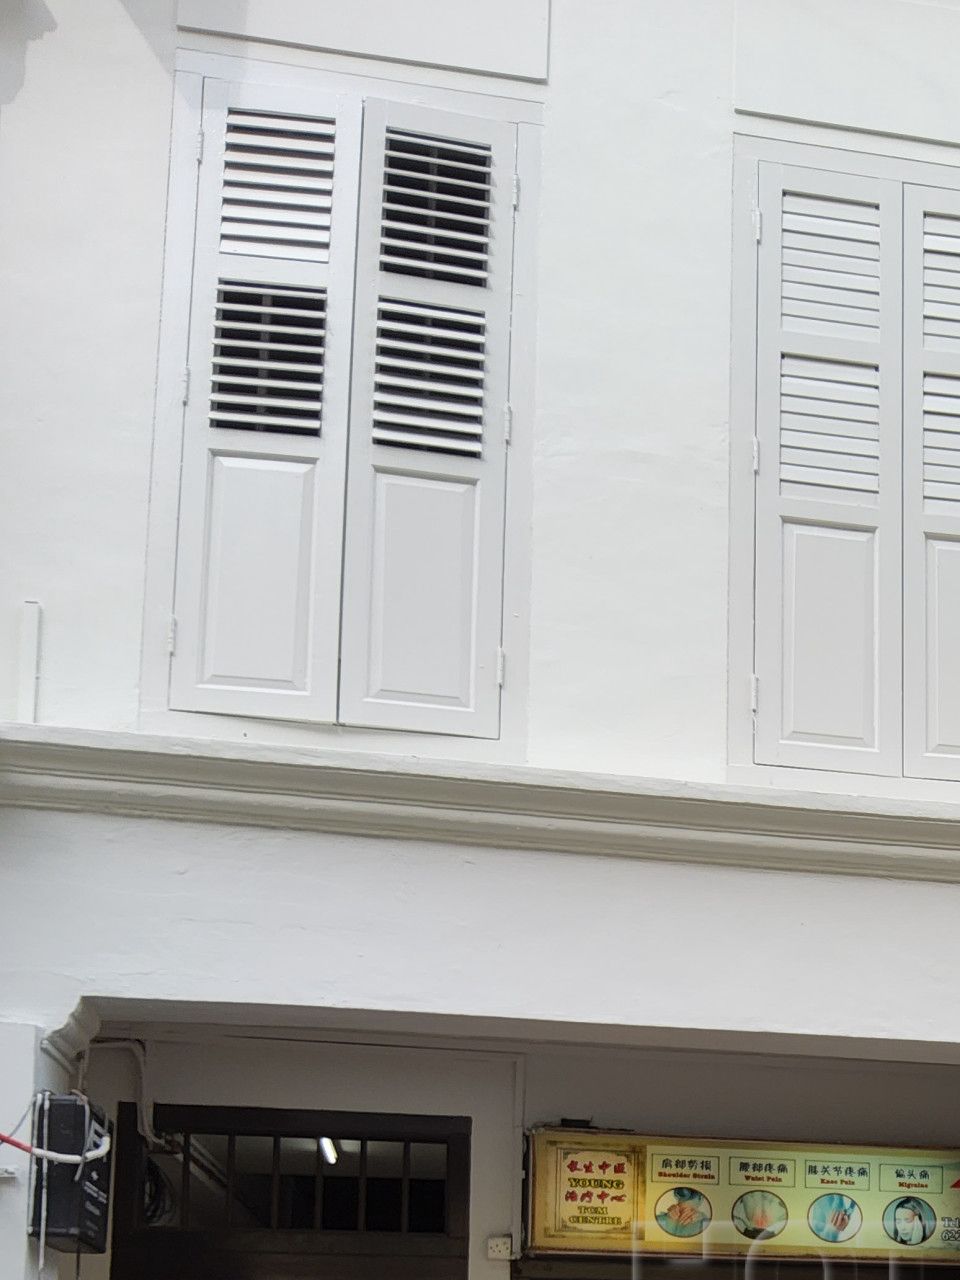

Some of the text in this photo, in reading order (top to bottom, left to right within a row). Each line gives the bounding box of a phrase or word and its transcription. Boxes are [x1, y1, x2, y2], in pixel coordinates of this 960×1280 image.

[658, 1171, 691, 1179] Shoulder
[568, 1178, 625, 1189] YOUNG
[578, 1206, 608, 1215] TCM
[568, 1216, 622, 1225] CENTRE
